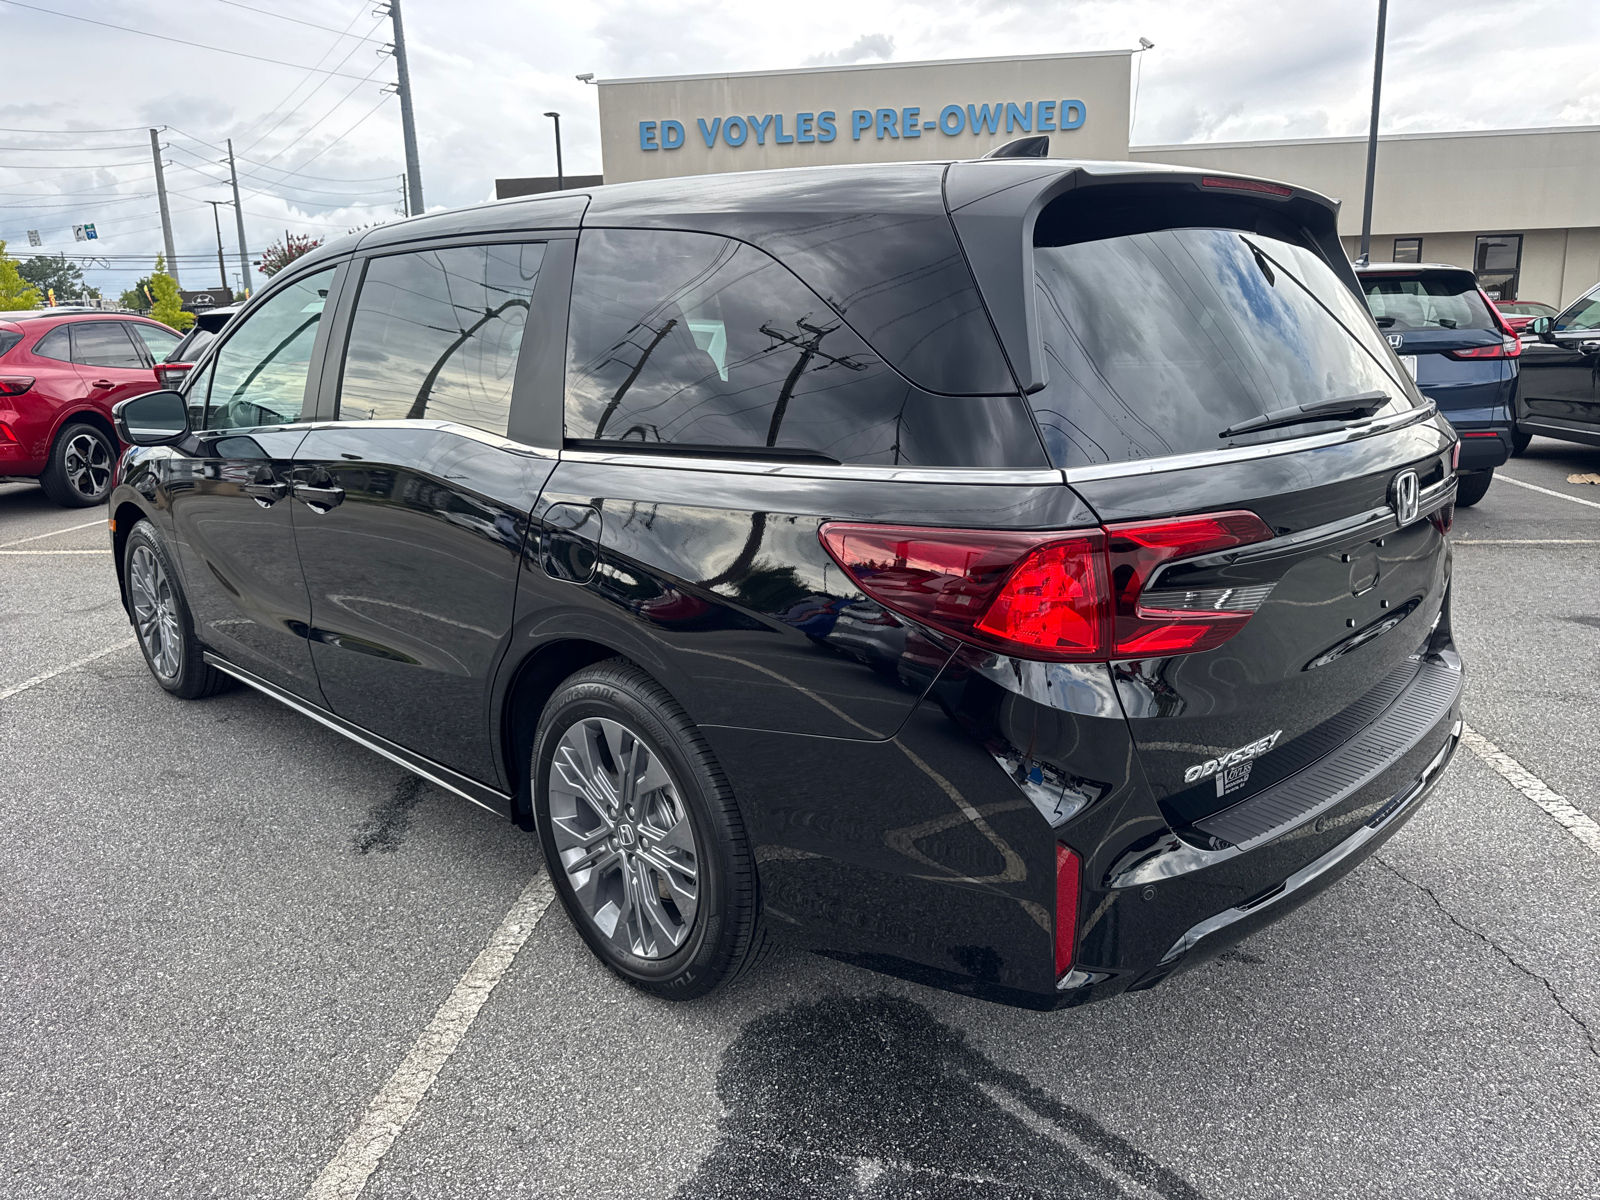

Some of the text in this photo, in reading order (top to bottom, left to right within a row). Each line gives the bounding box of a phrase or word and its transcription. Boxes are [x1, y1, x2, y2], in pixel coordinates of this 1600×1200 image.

[639, 99, 1088, 151] ED VOYLES PRE-OWNED
[1184, 729, 1282, 783] ODYSSEY
[1224, 760, 1254, 785] VOYLES
